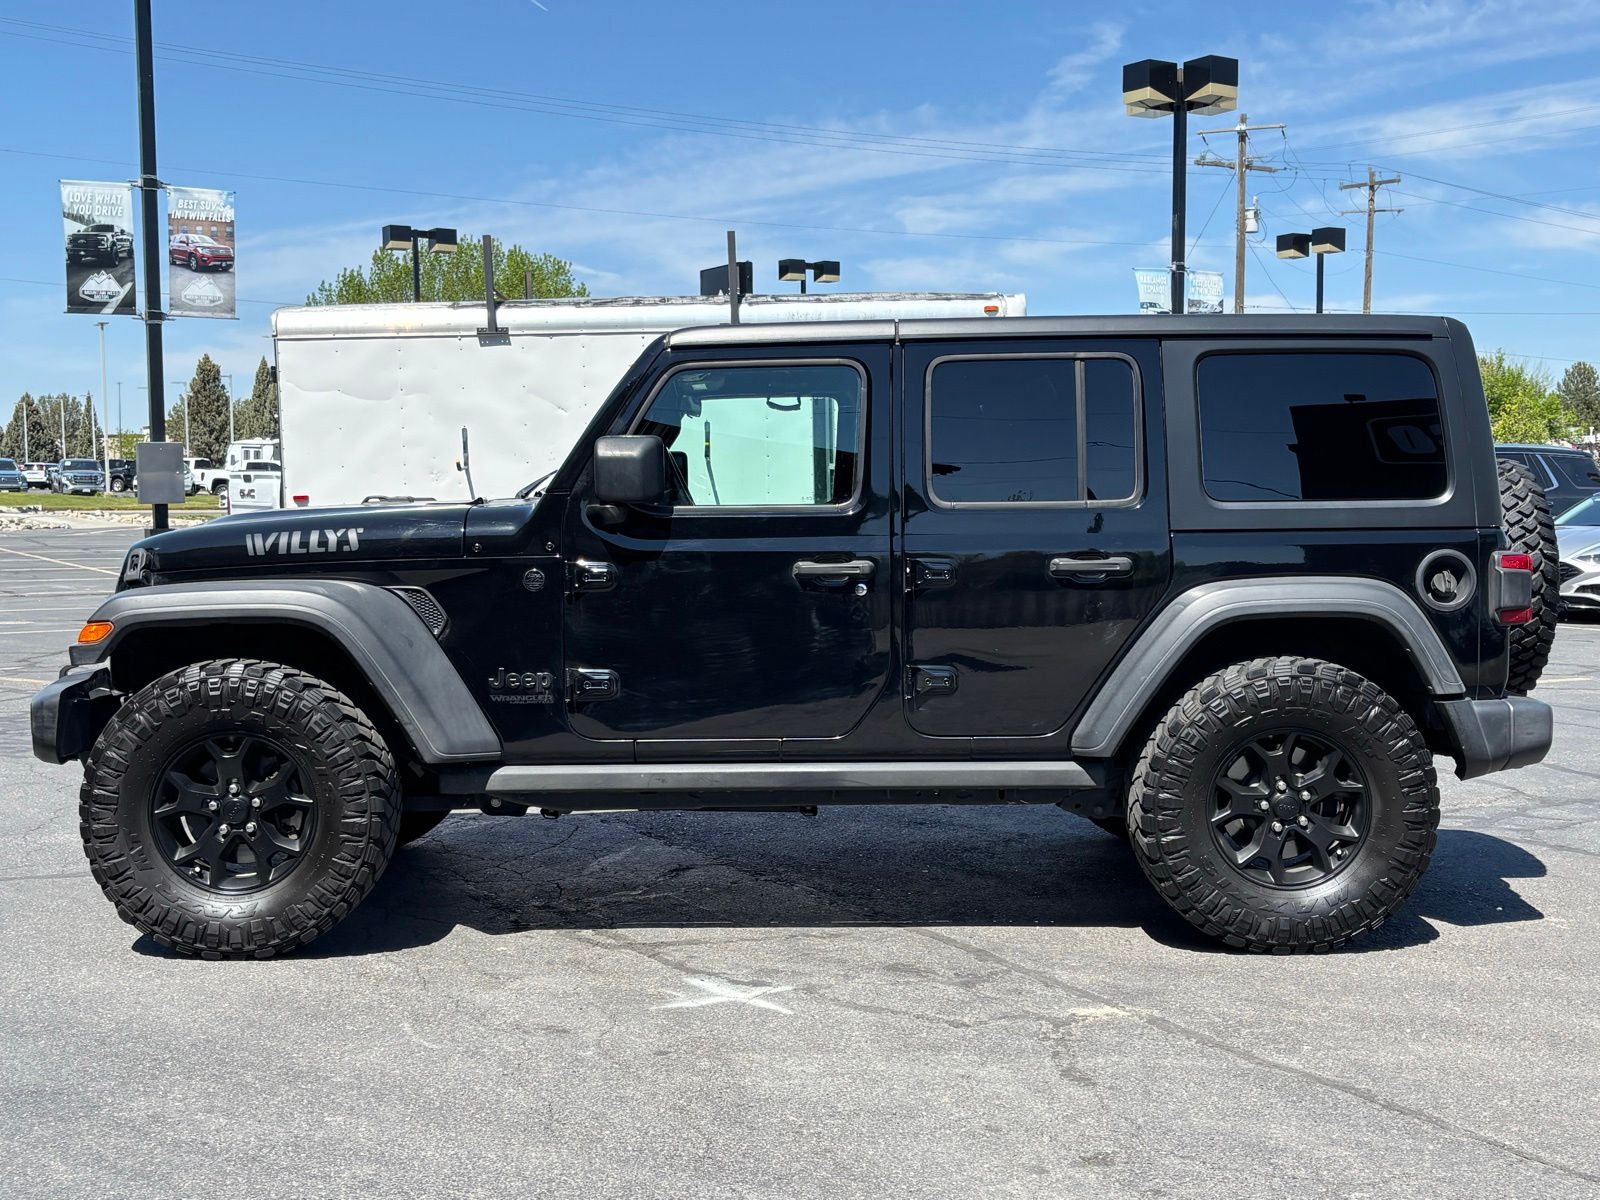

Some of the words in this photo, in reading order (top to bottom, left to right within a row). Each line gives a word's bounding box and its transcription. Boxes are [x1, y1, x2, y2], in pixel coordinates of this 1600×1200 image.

[69, 191, 93, 203] LOVE
[95, 193, 122, 205] WHAT
[178, 199, 198, 210] BEST
[73, 203, 92, 215] YOU
[95, 205, 123, 217] DRIVE
[171, 209, 182, 219] IN
[184, 210, 206, 221] TWIN
[208, 212, 231, 223] FALLS
[245, 527, 364, 556] WILLYS
[488, 667, 553, 693] Jeep
[489, 694, 554, 702] WRANGLER
